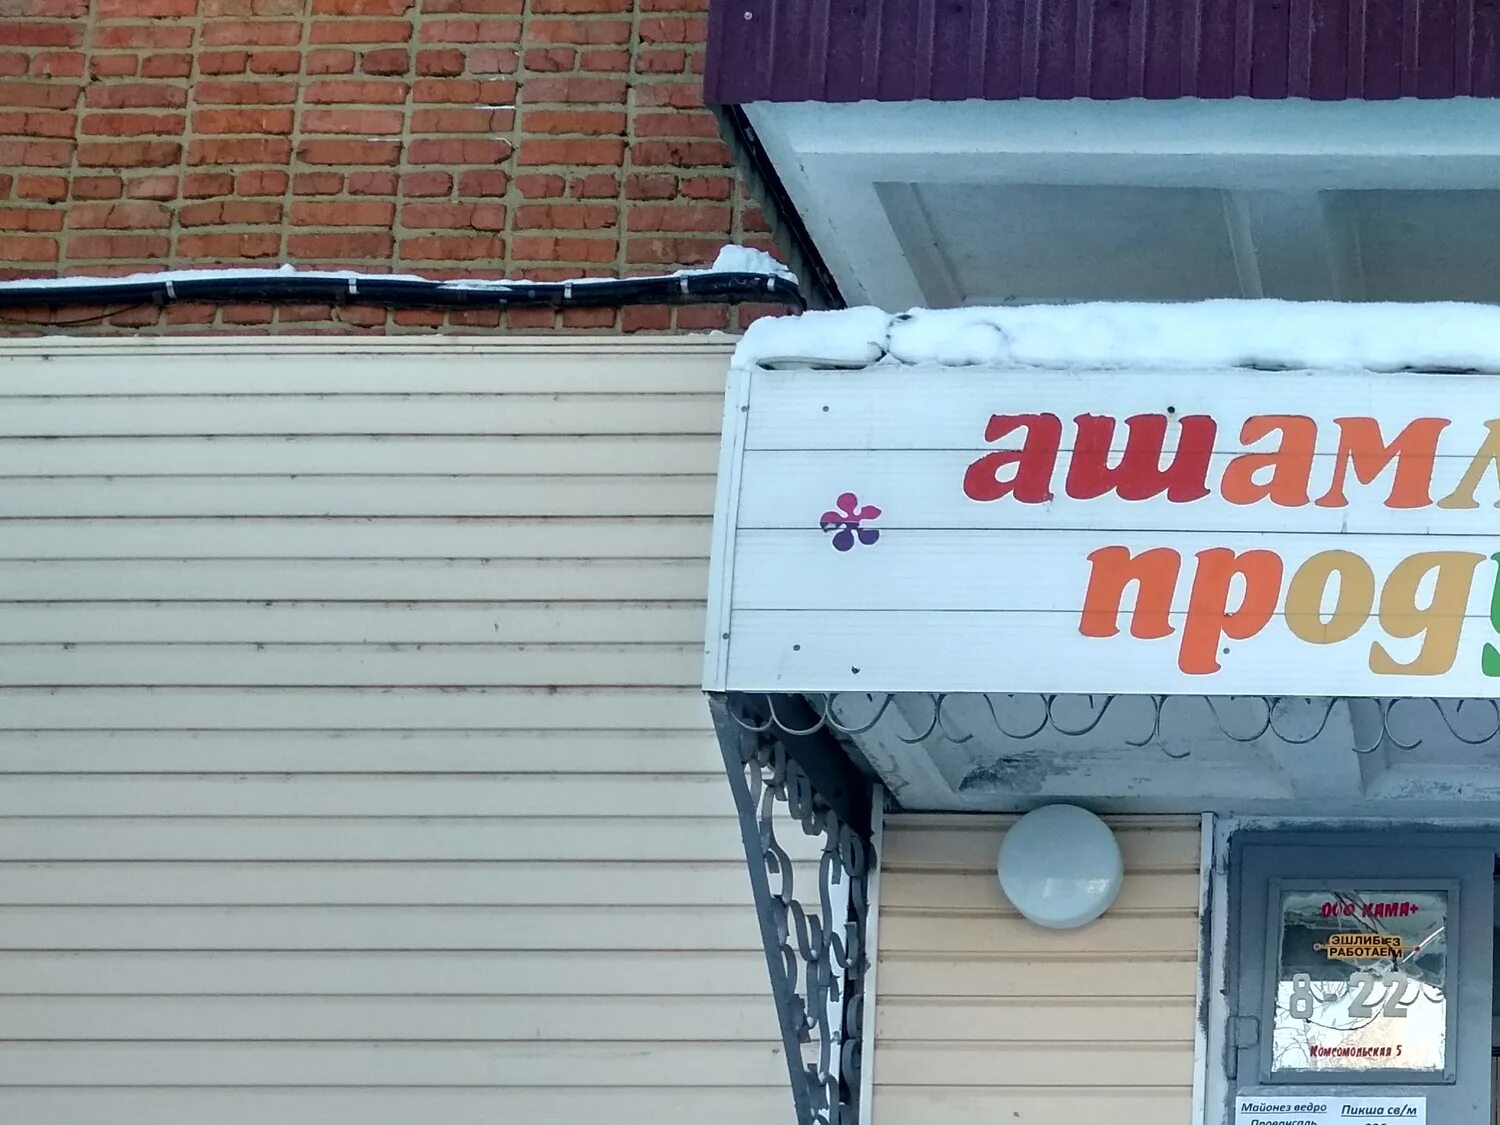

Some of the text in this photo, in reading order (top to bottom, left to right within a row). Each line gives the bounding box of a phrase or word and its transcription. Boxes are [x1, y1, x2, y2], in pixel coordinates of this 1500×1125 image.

[1329, 947, 1402, 958] РАБОТАЕМ
[1309, 1045, 1402, 1057] Комсомольская 5
[1241, 1102, 1327, 1113] Майонез ведро
[1341, 1104, 1417, 1117] Пикша св/м
